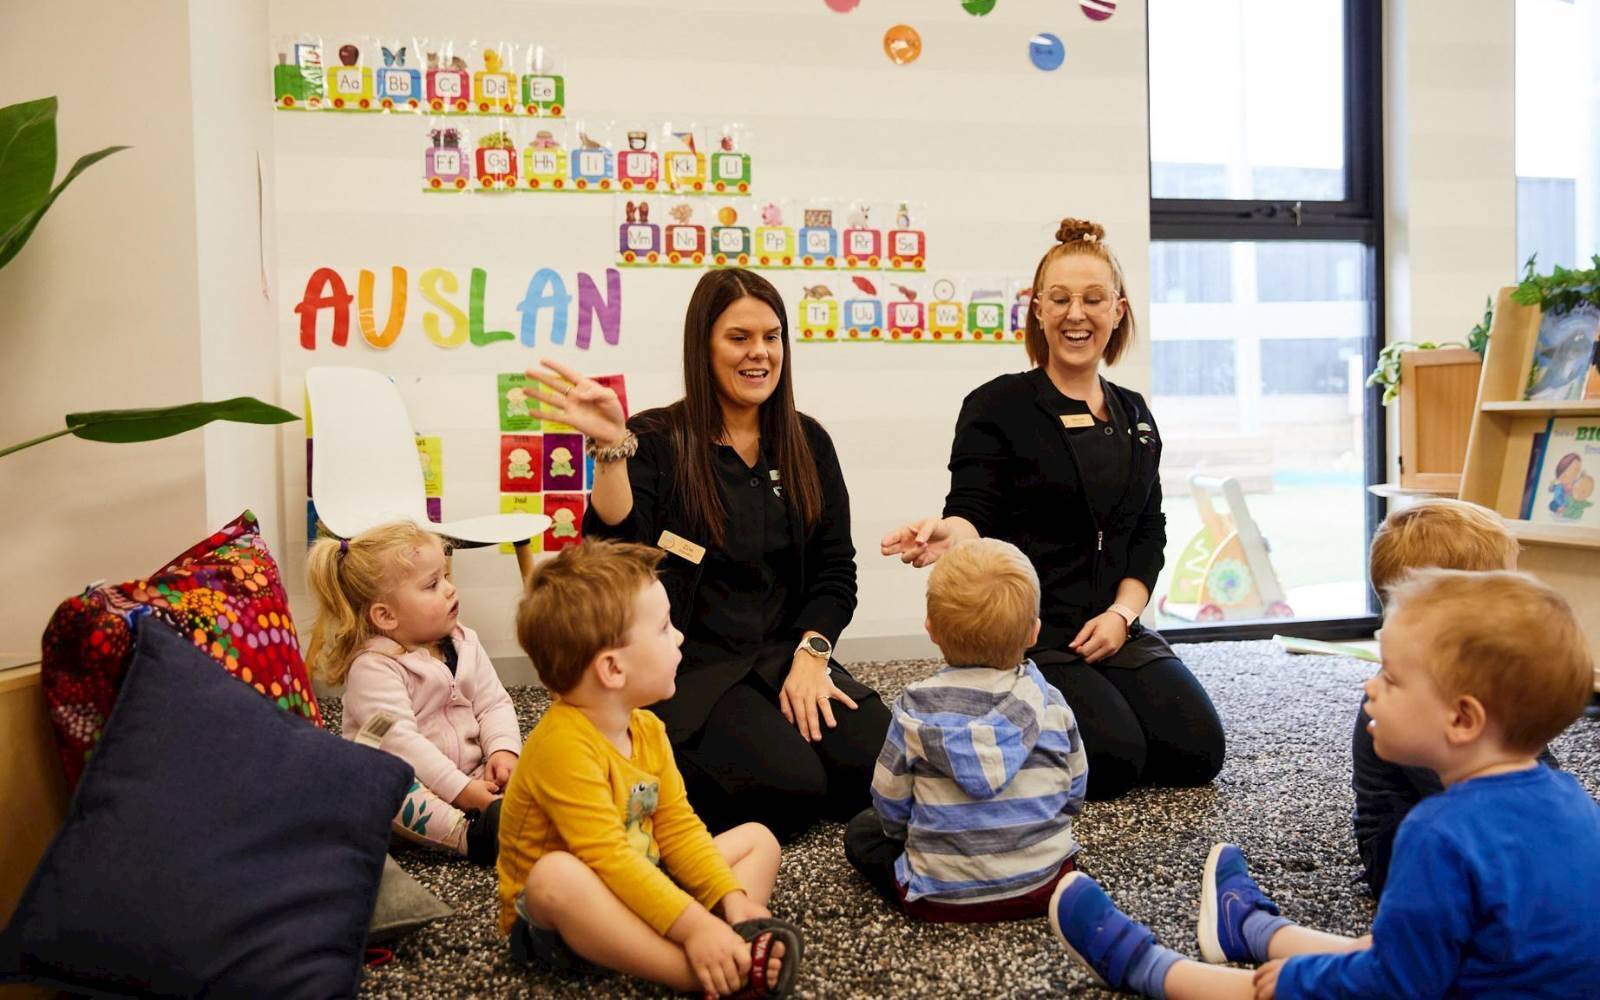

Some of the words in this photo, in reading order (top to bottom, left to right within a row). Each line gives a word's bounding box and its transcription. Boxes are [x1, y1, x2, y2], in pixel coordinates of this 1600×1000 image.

[340, 75, 360, 91] Aa
[389, 76, 409, 91] Bb
[439, 76, 458, 93] Cc
[486, 77, 506, 95] Dd
[532, 81, 552, 97] Ee
[437, 155, 456, 169] Ff
[488, 154, 508, 171] Gg
[535, 155, 554, 168] Hh
[586, 156, 598, 171] Ii
[631, 155, 647, 174] Jj
[674, 158, 694, 173] Kk
[725, 159, 739, 175] Ll
[629, 232, 650, 245] Mm
[677, 233, 695, 248] Nn
[722, 233, 740, 246] Oo
[766, 232, 784, 249] Pp
[809, 232, 827, 249] Qq
[854, 232, 871, 248] Rr
[898, 234, 915, 250] Ss
[294, 266, 621, 350] AUSLAN
[811, 306, 827, 321] Tt
[855, 307, 873, 321] Uu
[900, 309, 915, 322] Vv
[981, 310, 996, 323] Xx
